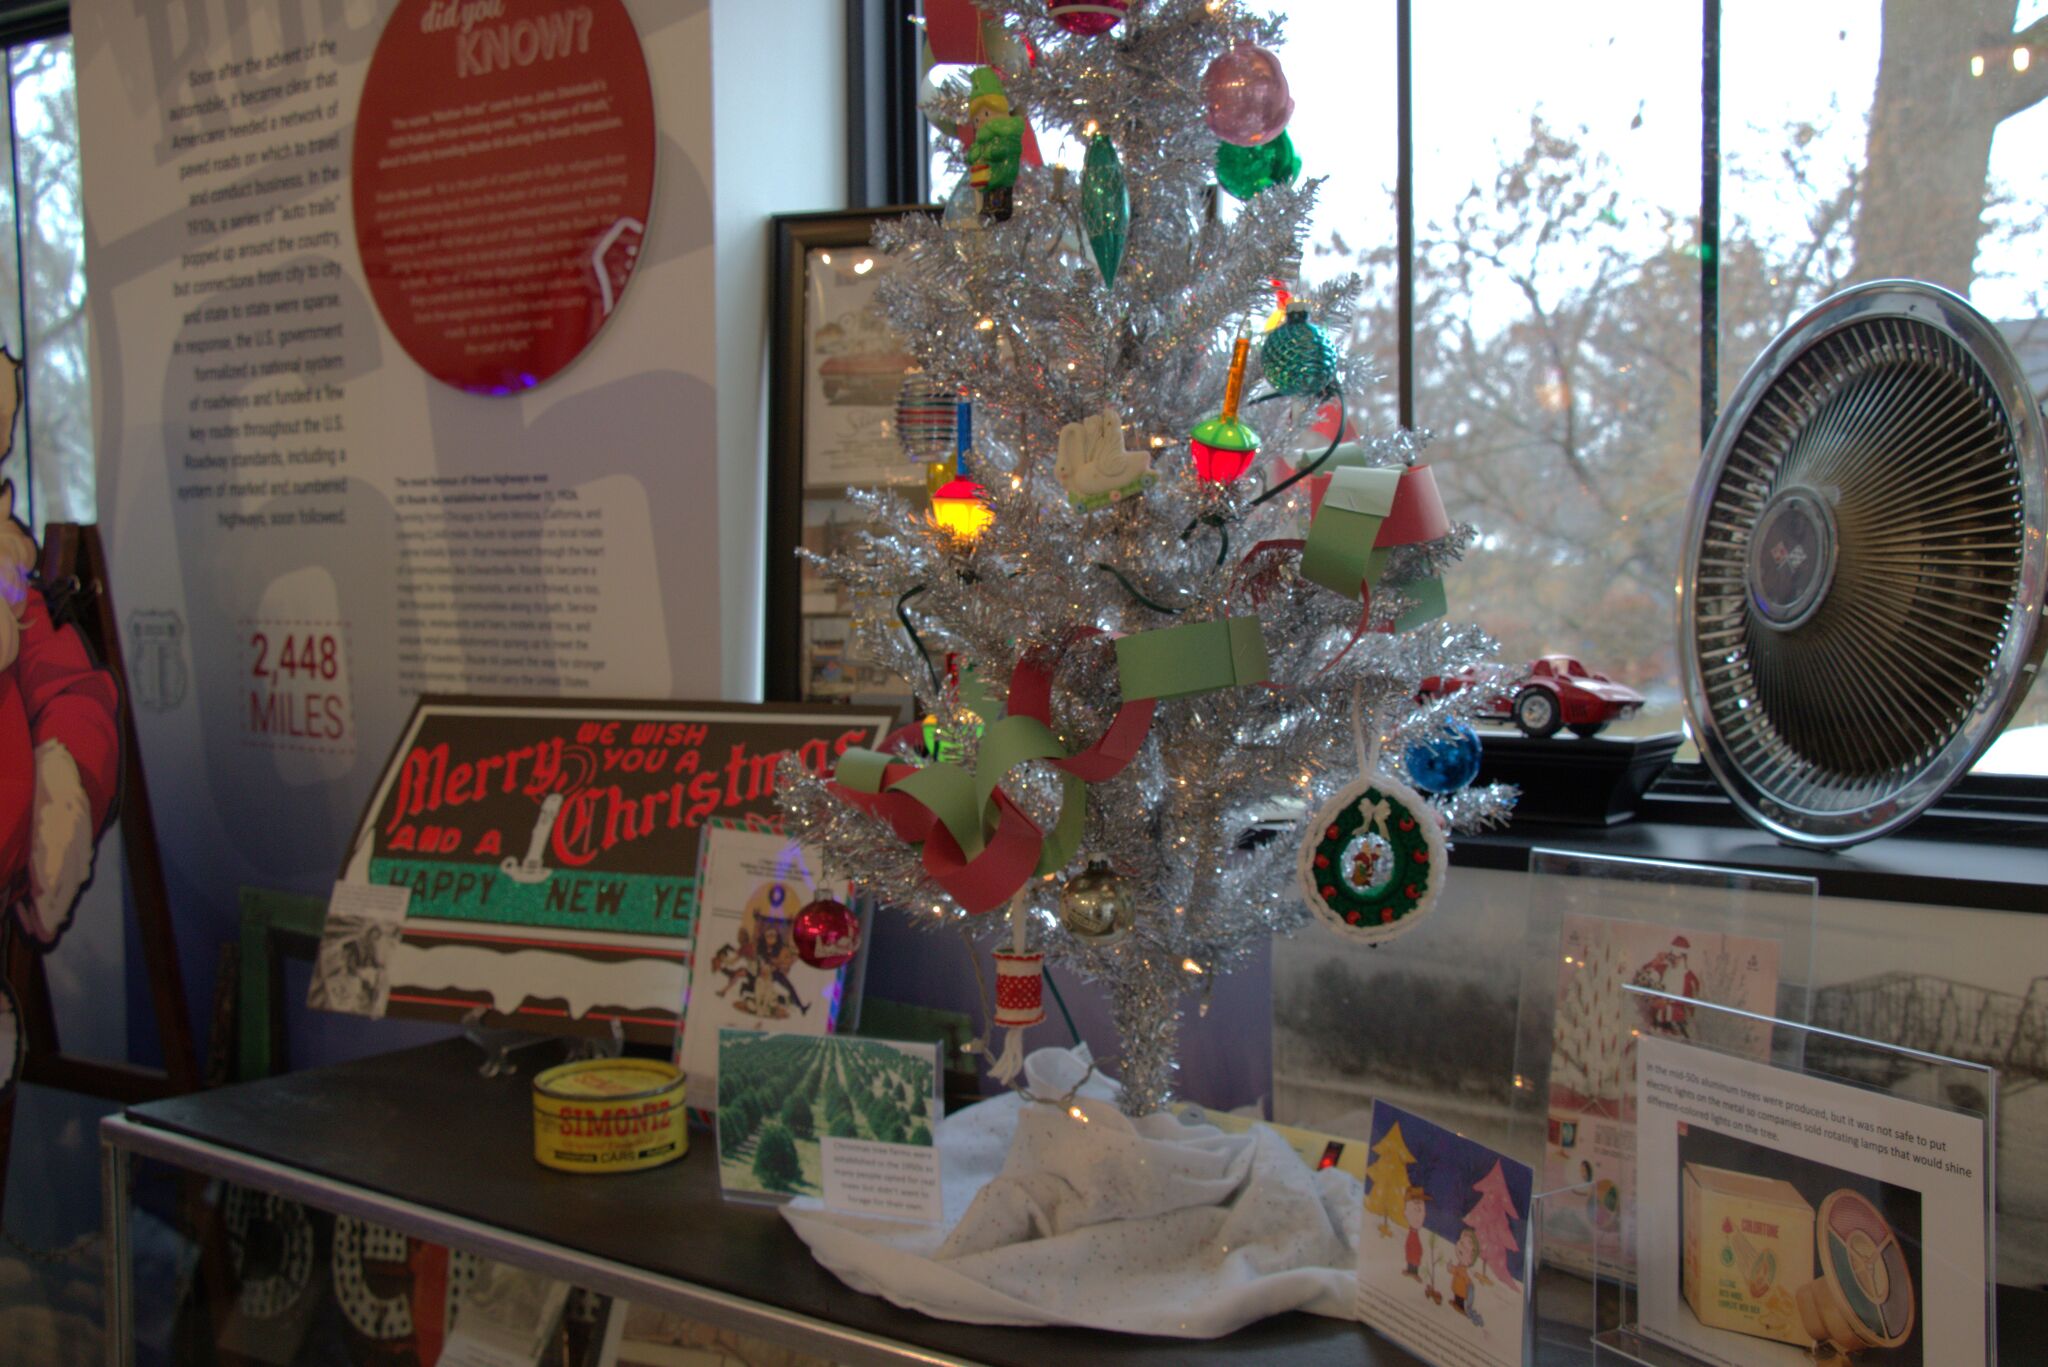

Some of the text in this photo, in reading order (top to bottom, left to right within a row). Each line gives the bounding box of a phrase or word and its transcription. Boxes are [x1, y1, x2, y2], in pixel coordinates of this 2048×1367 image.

[421, 0, 506, 33] did you
[455, 6, 593, 79] KNOW?
[249, 632, 338, 686] 2,448
[250, 690, 345, 740] MILES
[576, 722, 708, 746] WE WISH
[603, 749, 701, 773] YOU A
[387, 824, 502, 855] AND A
[389, 867, 497, 905] HAPPY
[545, 878, 628, 916] NEW
[653, 884, 692, 920] YE
[559, 1099, 672, 1137] SIMONIZ
[1646, 1095, 1780, 1141] different-colored lights on the tree.
[1646, 1080, 1972, 1178] electric lights on the metal so companies sold rotating lamps that would shine
[1655, 1066, 1667, 1075] the
[1669, 1070, 1699, 1084] mid-50s
[1701, 1078, 1739, 1094] aluminum
[1741, 1088, 1760, 1101] trees
[1763, 1096, 1783, 1106] were
[1785, 1102, 1828, 1120] produced,
[1831, 1111, 1845, 1124] but
[1848, 1118, 1854, 1127] it
[1857, 1121, 1874, 1131] was
[1877, 1125, 1892, 1137] not
[1895, 1130, 1914, 1143] safe
[1917, 1136, 1927, 1146] to
[1929, 1140, 1946, 1153] put
[600, 1151, 636, 1163] CARS
